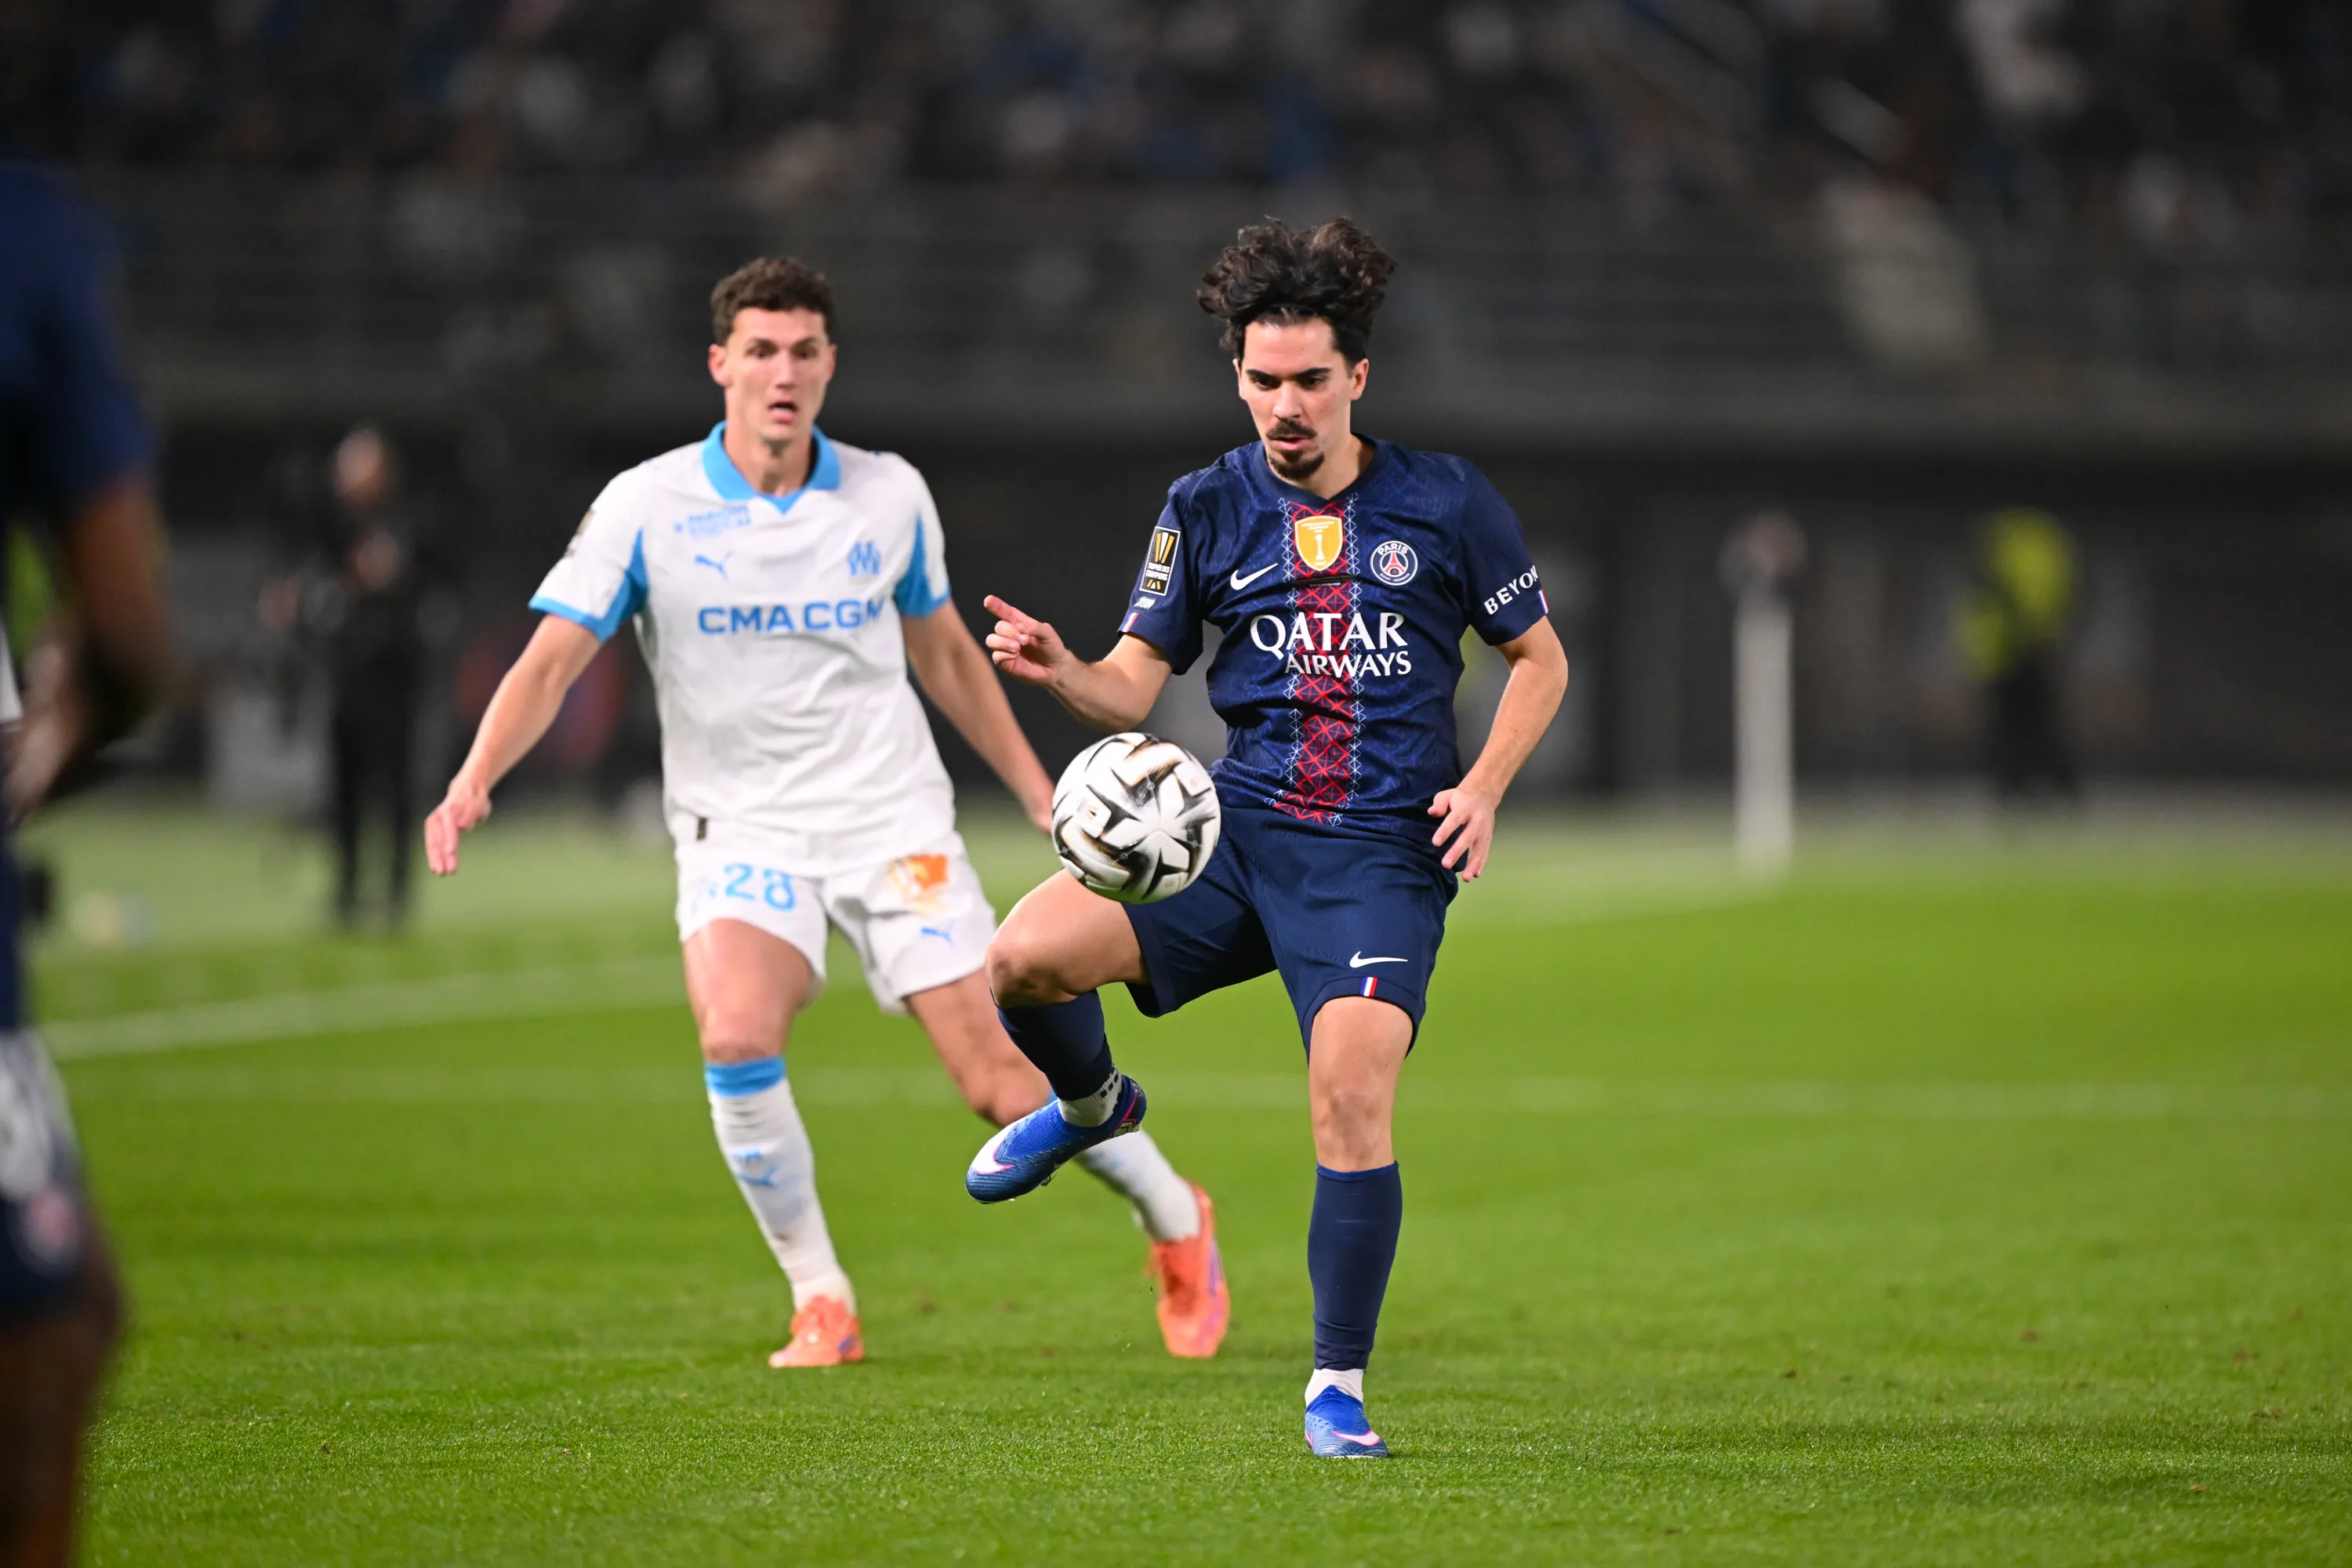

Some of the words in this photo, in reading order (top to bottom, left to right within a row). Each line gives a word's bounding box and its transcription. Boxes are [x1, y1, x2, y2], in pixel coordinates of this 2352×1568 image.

[1377, 543, 1409, 555] PARIS
[698, 604, 795, 634] CMA
[1250, 612, 1408, 660] QATAR
[1284, 651, 1412, 678] AIRWAYS
[724, 862, 796, 913] 28
